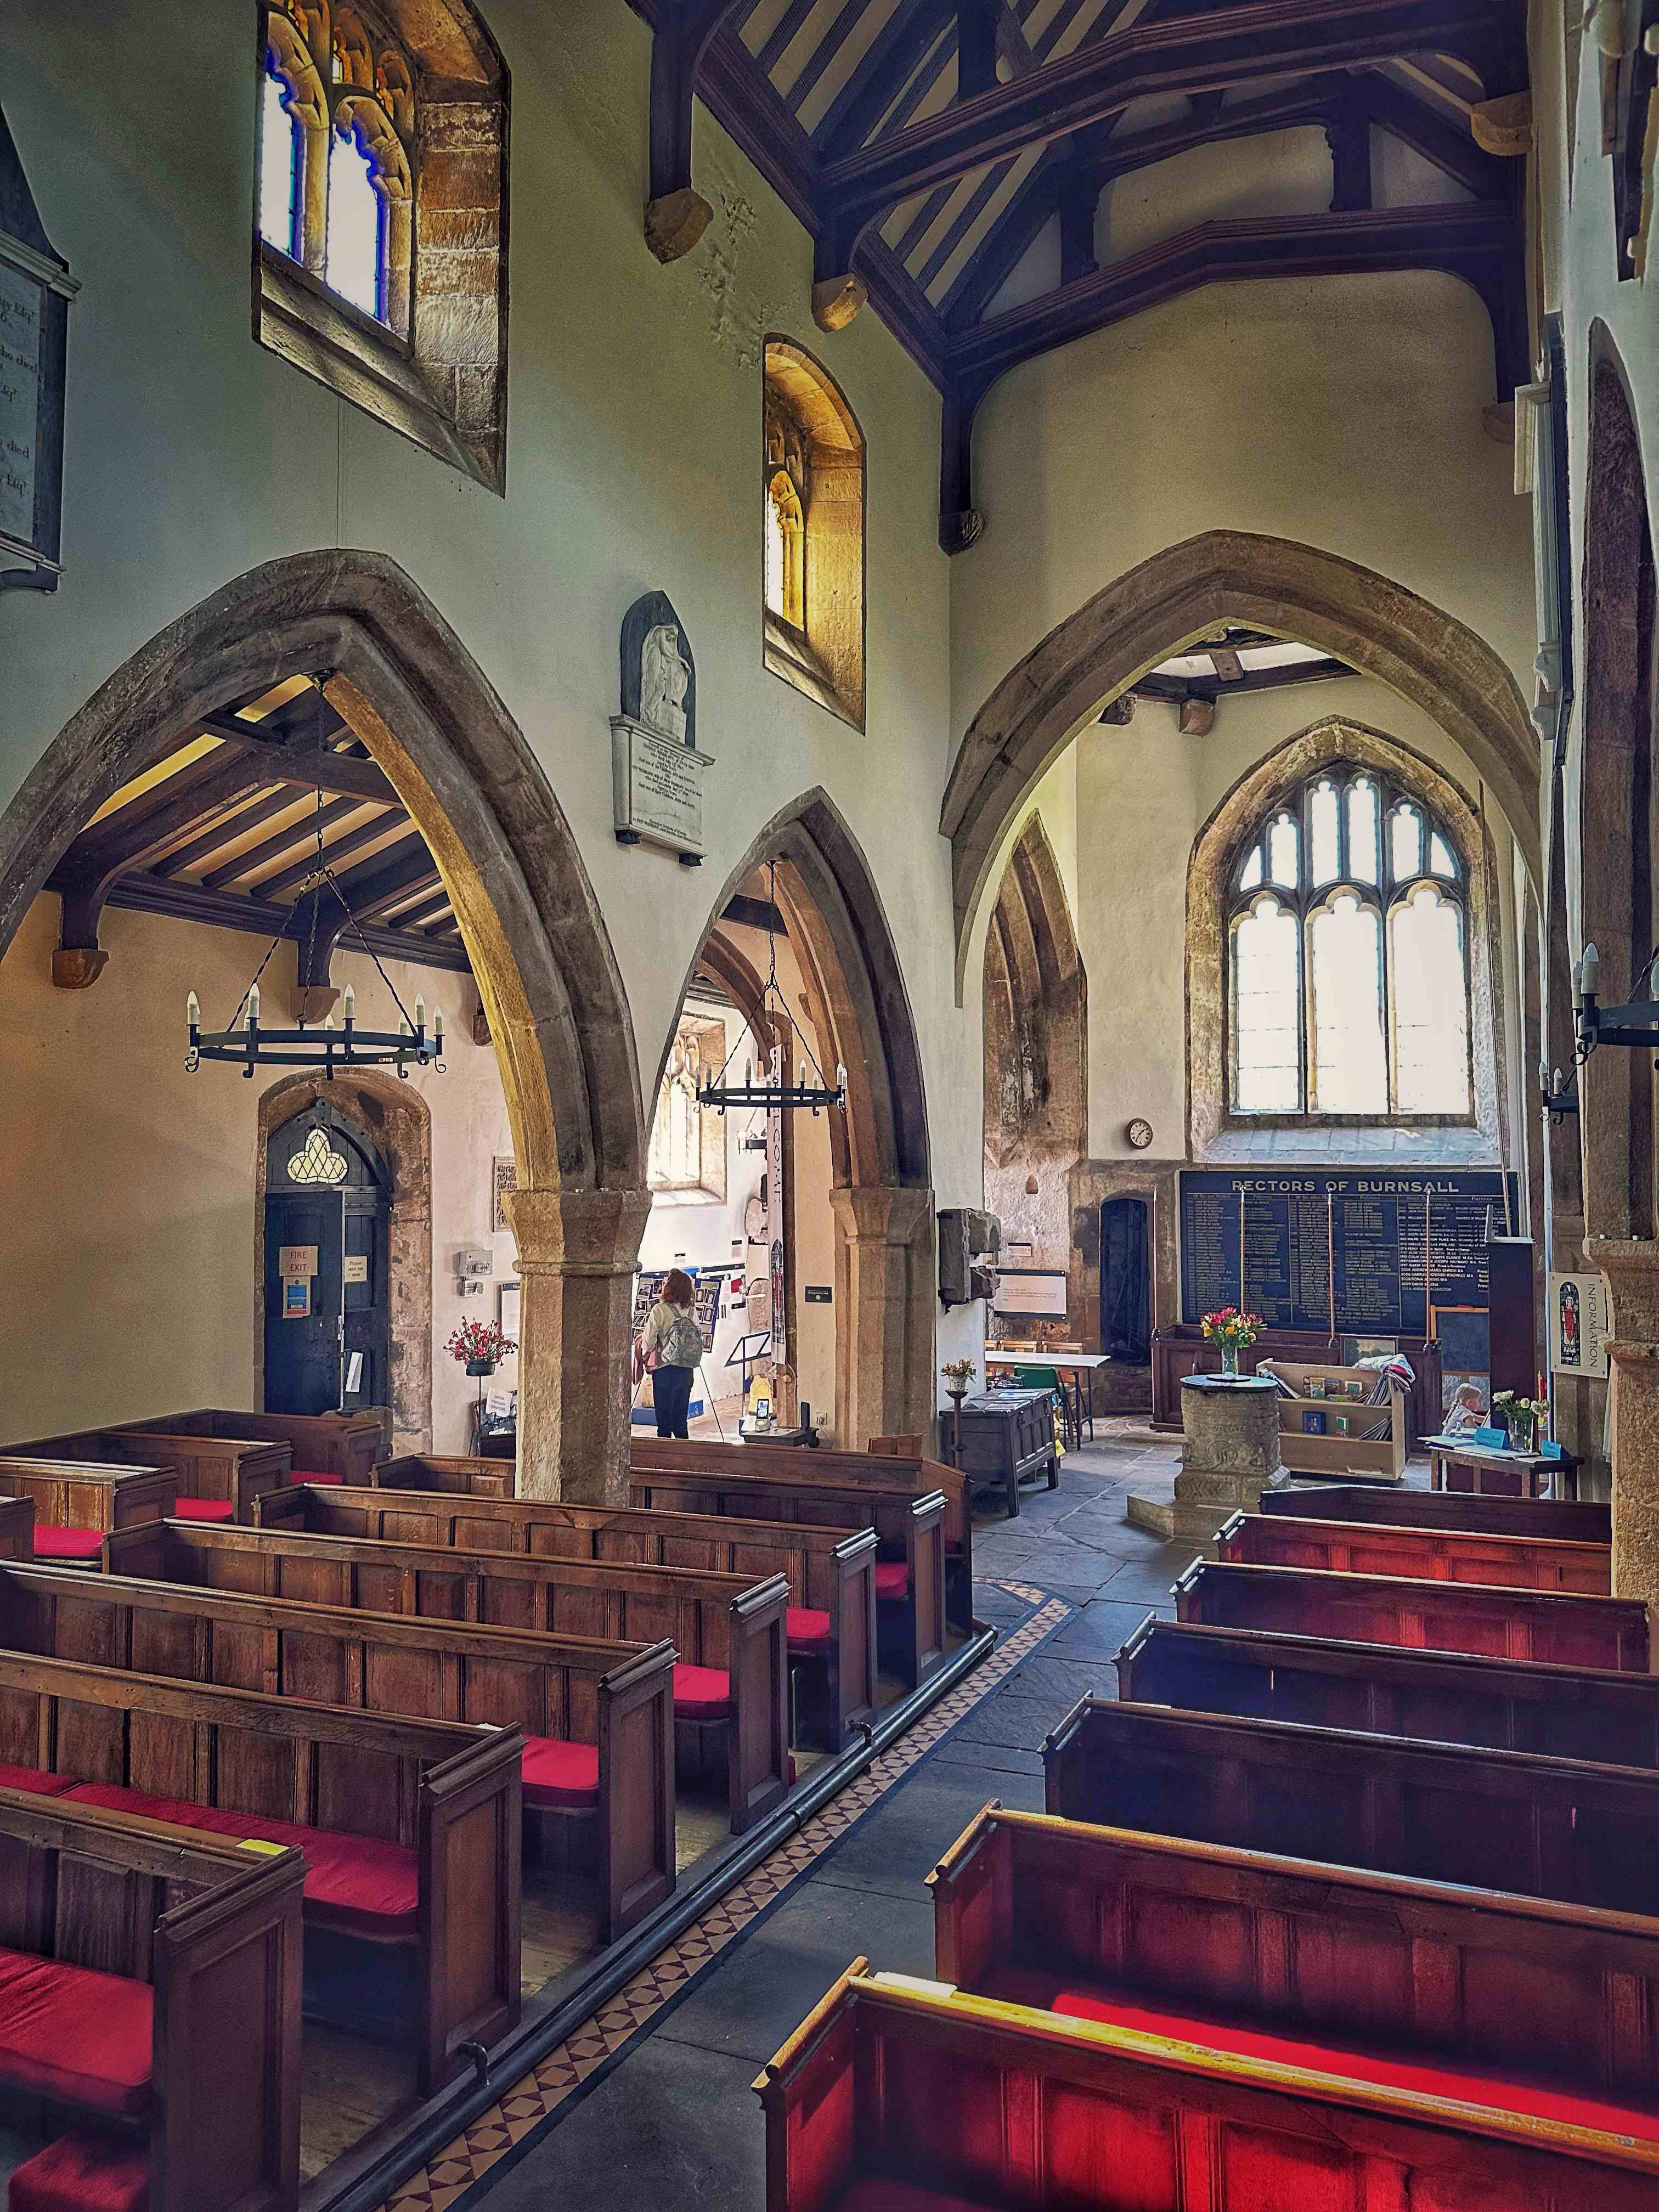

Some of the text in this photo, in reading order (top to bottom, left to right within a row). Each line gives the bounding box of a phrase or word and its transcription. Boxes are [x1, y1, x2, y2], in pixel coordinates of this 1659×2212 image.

[16, 356, 38, 374] died
[7, 440, 29, 459] died
[1232, 1180, 1459, 1193] RECTORS OF BURNSALL
[290, 1251, 307, 1259] FIRE
[290, 1263, 307, 1272] EXIT
[1588, 1283, 1598, 1368] INFORMATION
